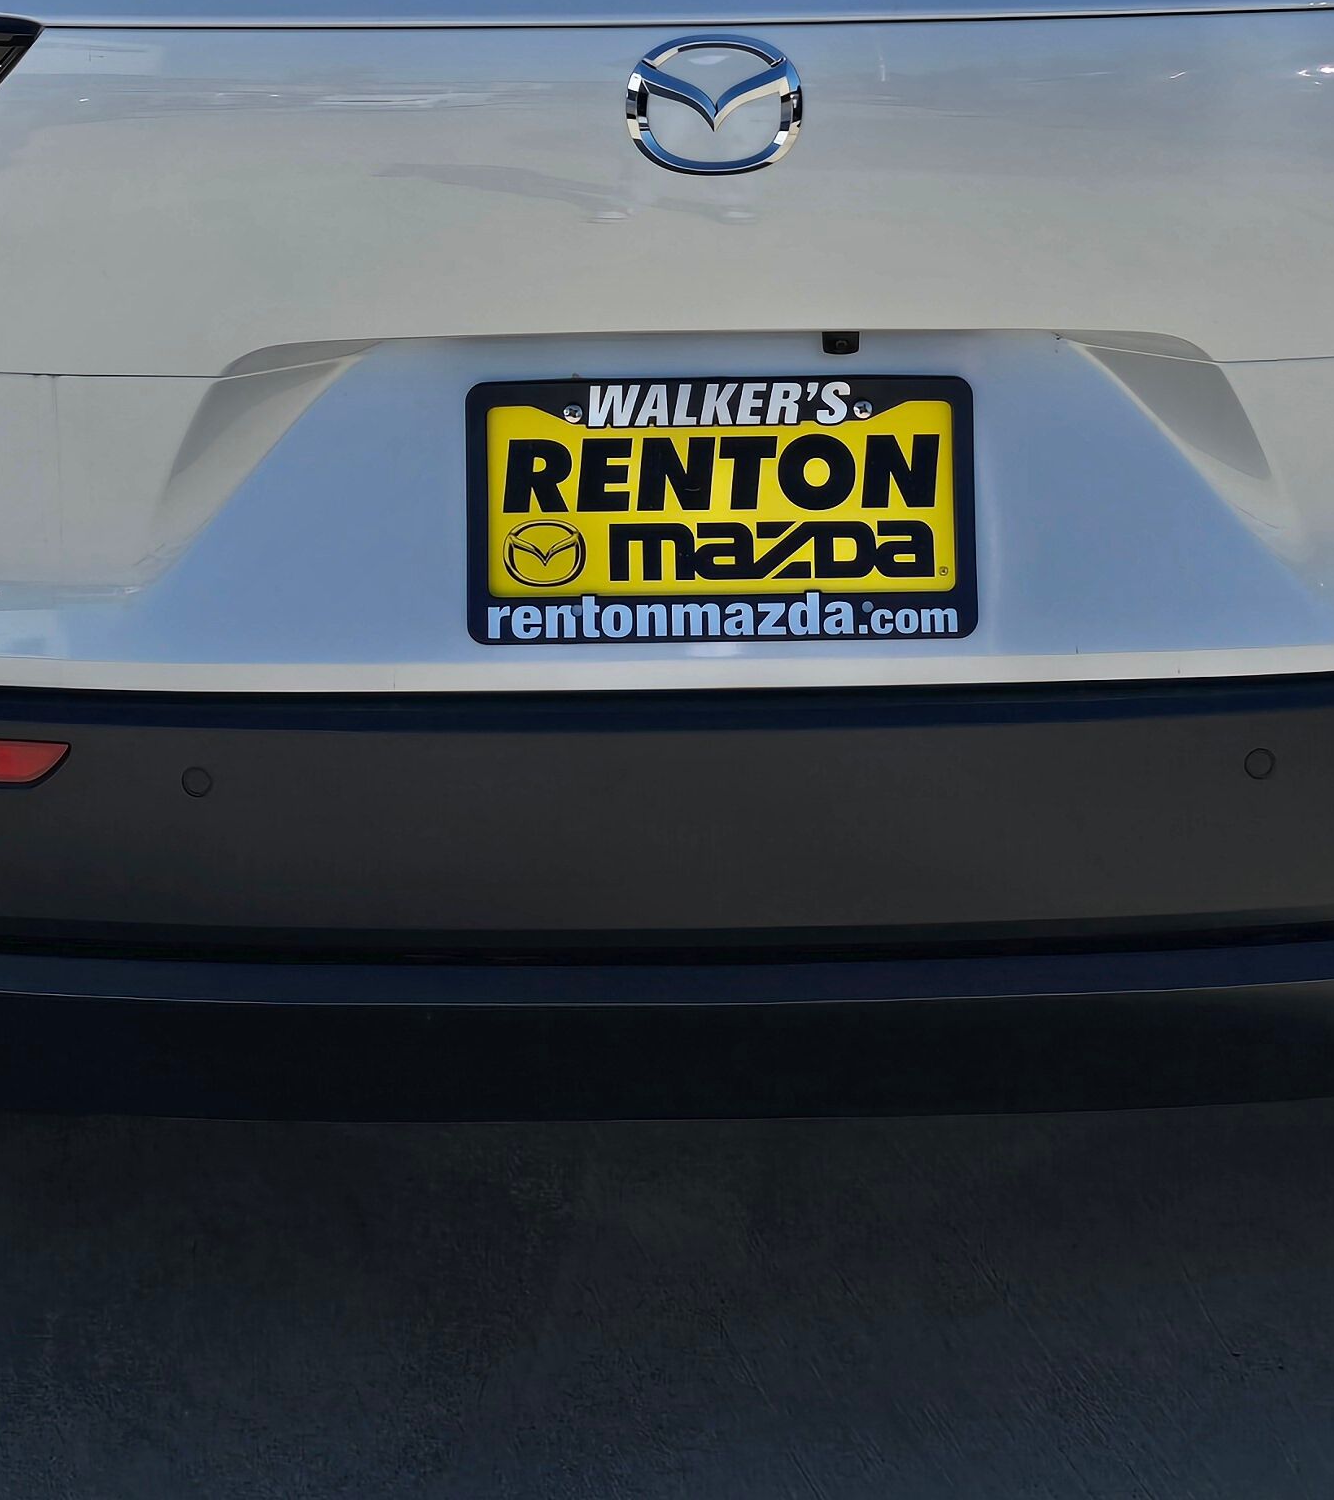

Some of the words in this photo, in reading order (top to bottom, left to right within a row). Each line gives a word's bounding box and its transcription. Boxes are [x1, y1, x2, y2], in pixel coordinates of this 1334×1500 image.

[586, 380, 852, 430] WALKER'S
[502, 434, 941, 514] RENTON
[486, 591, 959, 640] rentonmazda.com
